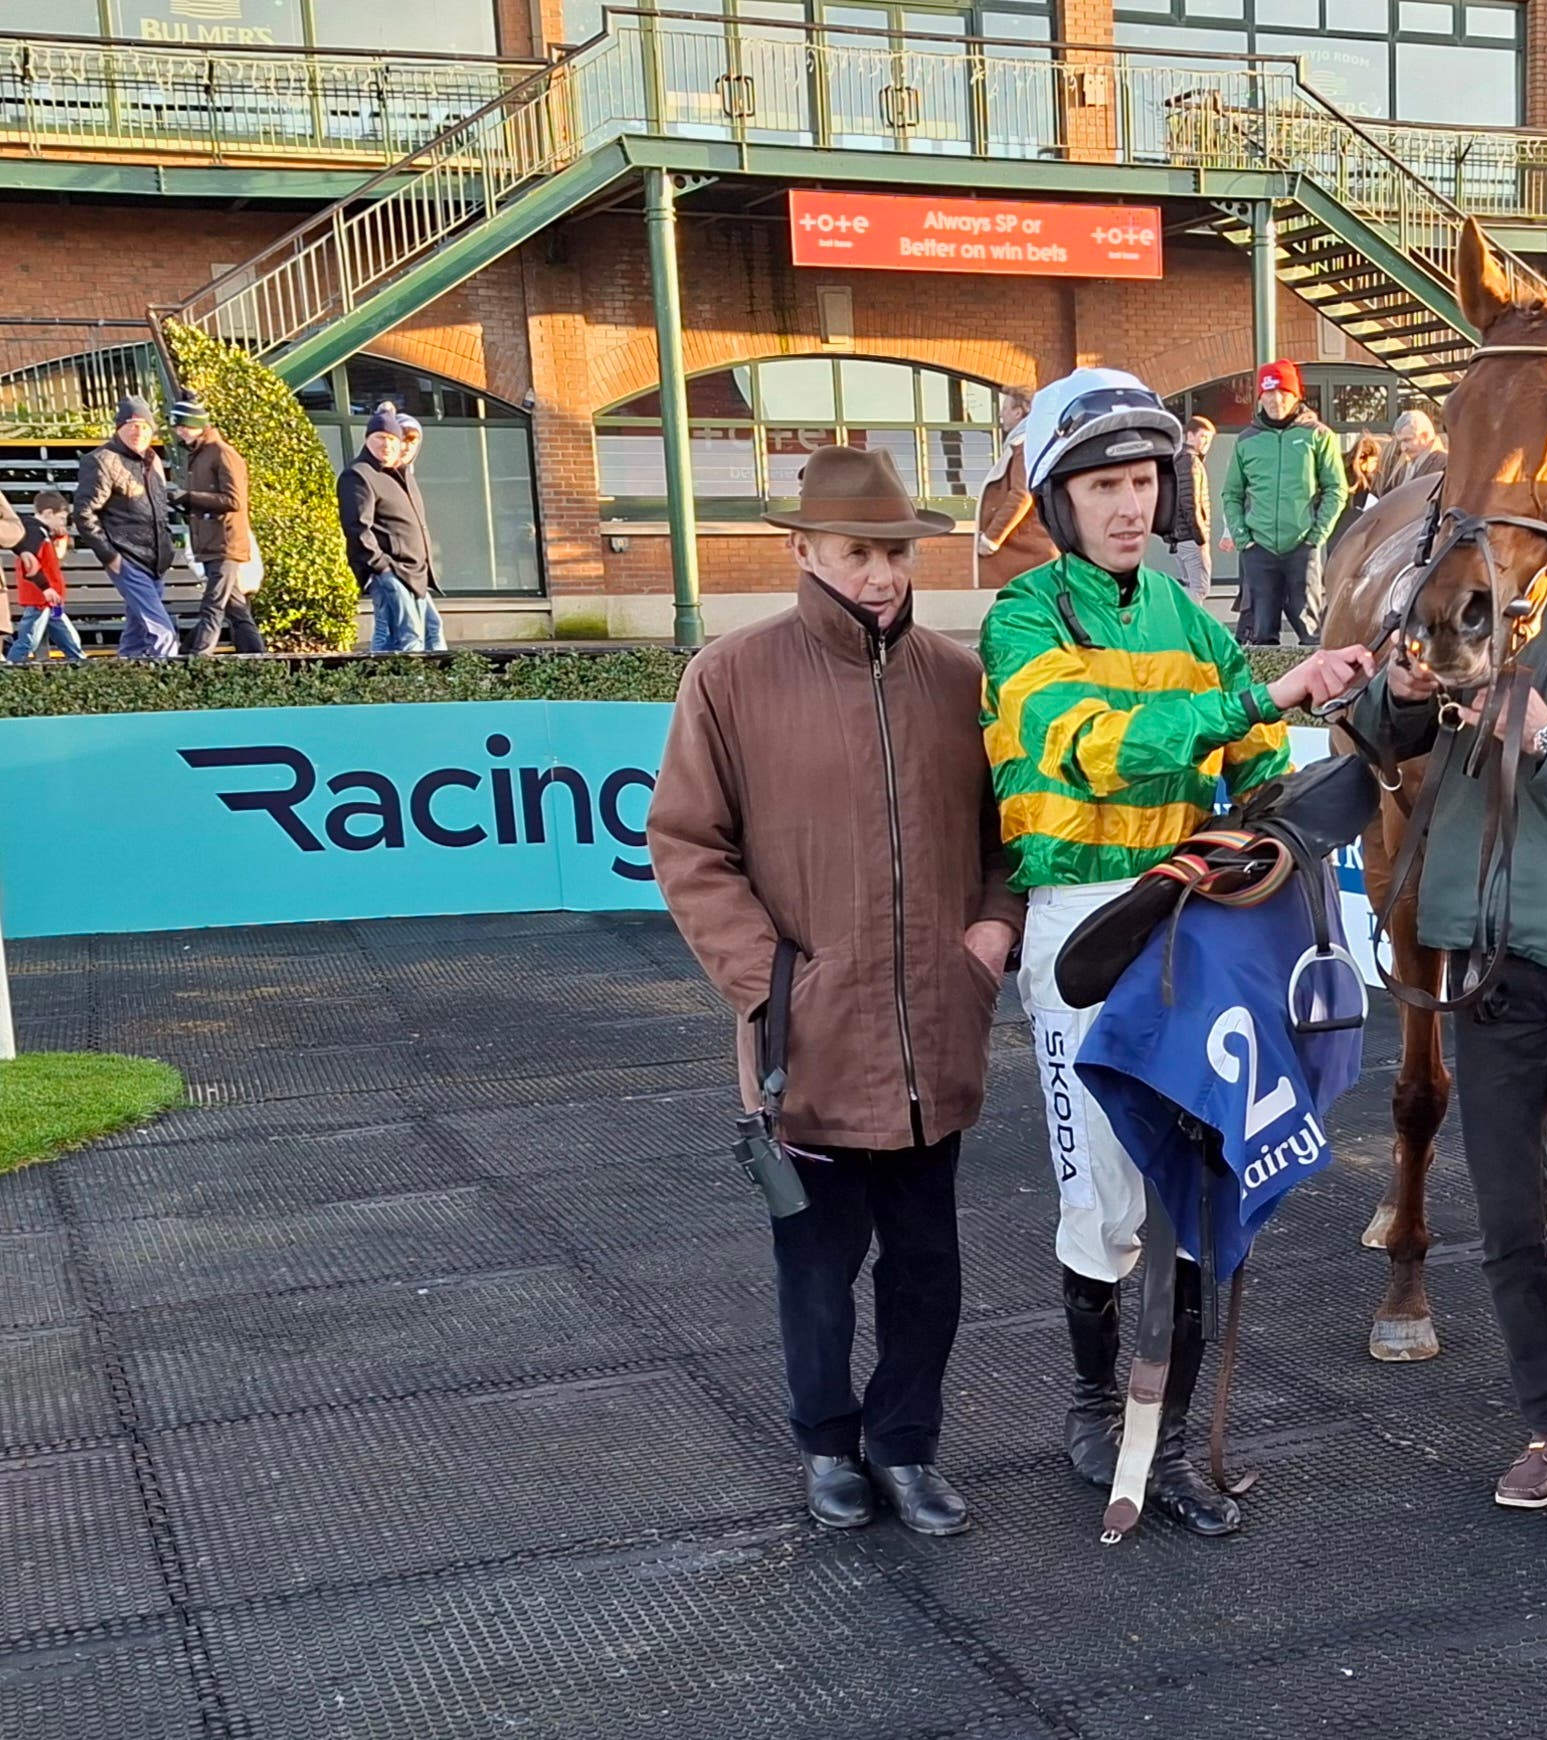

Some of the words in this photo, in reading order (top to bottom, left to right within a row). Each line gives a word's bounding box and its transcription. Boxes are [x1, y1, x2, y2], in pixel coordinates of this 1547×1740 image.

[900, 236, 956, 258] Better
[960, 243, 986, 259] on
[990, 242, 1023, 260] win
[1027, 243, 1068, 262] bets
[923, 211, 992, 235] Always
[995, 214, 1018, 233] SP
[1022, 219, 1042, 234] or
[176, 733, 660, 881] Racing
[1206, 1006, 1297, 1141] 2
